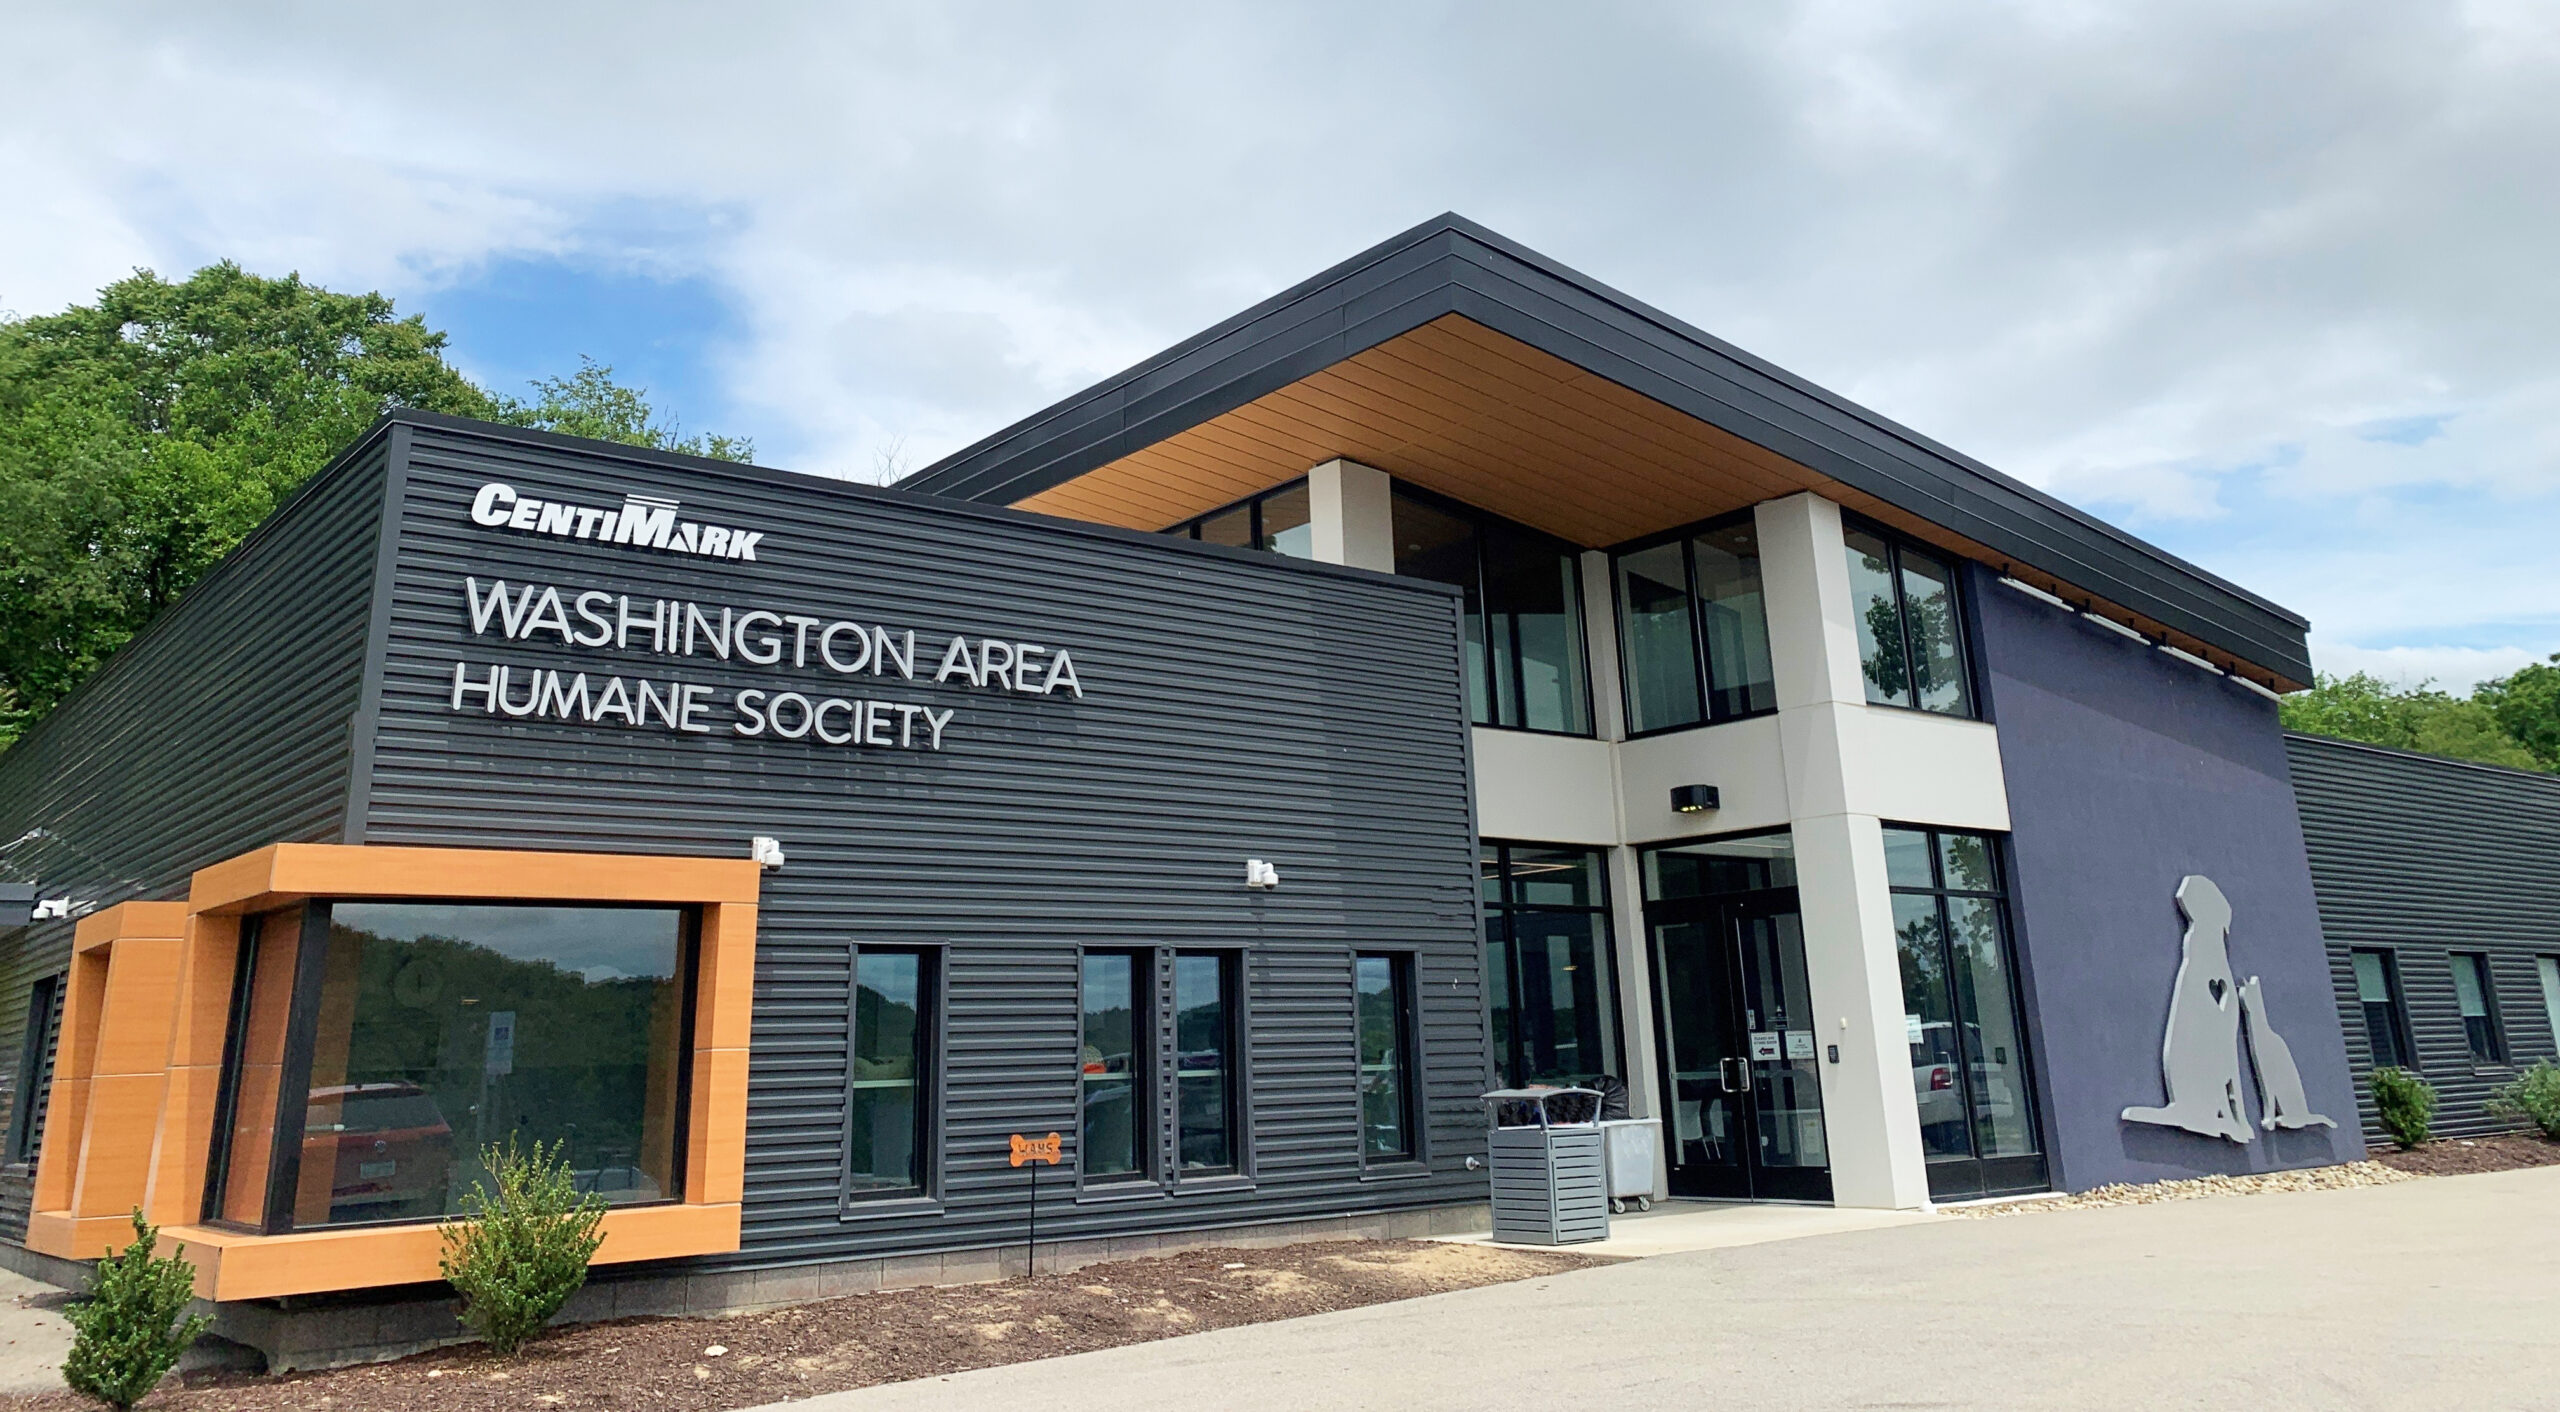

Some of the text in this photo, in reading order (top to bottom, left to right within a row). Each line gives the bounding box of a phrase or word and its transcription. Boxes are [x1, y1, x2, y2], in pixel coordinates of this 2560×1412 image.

[471, 483, 764, 561] CENTIMARK
[466, 577, 1083, 698] WASHINGTON AREA
[453, 663, 954, 750] HUMANE SOCIETY
